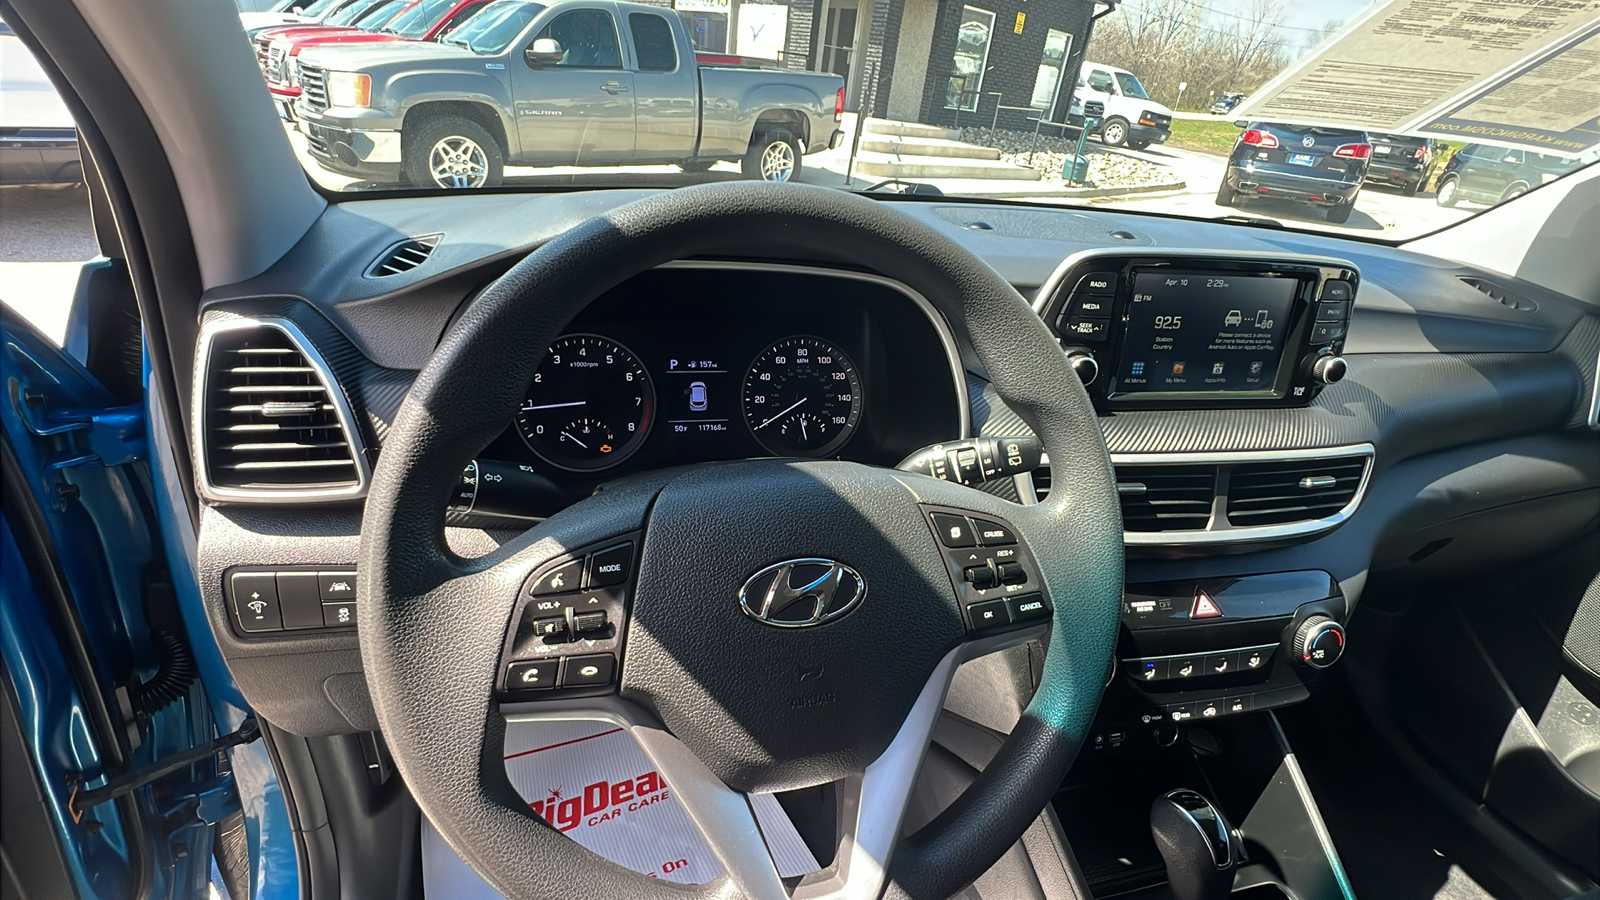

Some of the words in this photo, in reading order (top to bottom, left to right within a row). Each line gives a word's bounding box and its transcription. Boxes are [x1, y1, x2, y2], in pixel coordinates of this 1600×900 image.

[1154, 316, 1182, 329] 92.5
[580, 348, 586, 356] 4
[554, 355, 561, 364] 3
[606, 355, 613, 364] 5
[670, 359, 678, 369] P
[534, 374, 542, 382] 2
[626, 372, 633, 381] 6
[528, 399, 533, 408] 1
[635, 397, 641, 406] 7
[536, 425, 543, 434] 0
[628, 422, 635, 431] 8
[599, 564, 621, 573] MODE
[1020, 602, 1042, 612] CANCEL
[588, 808, 621, 827] CAR
[628, 791, 670, 812] CARE
[662, 858, 688, 874] On
